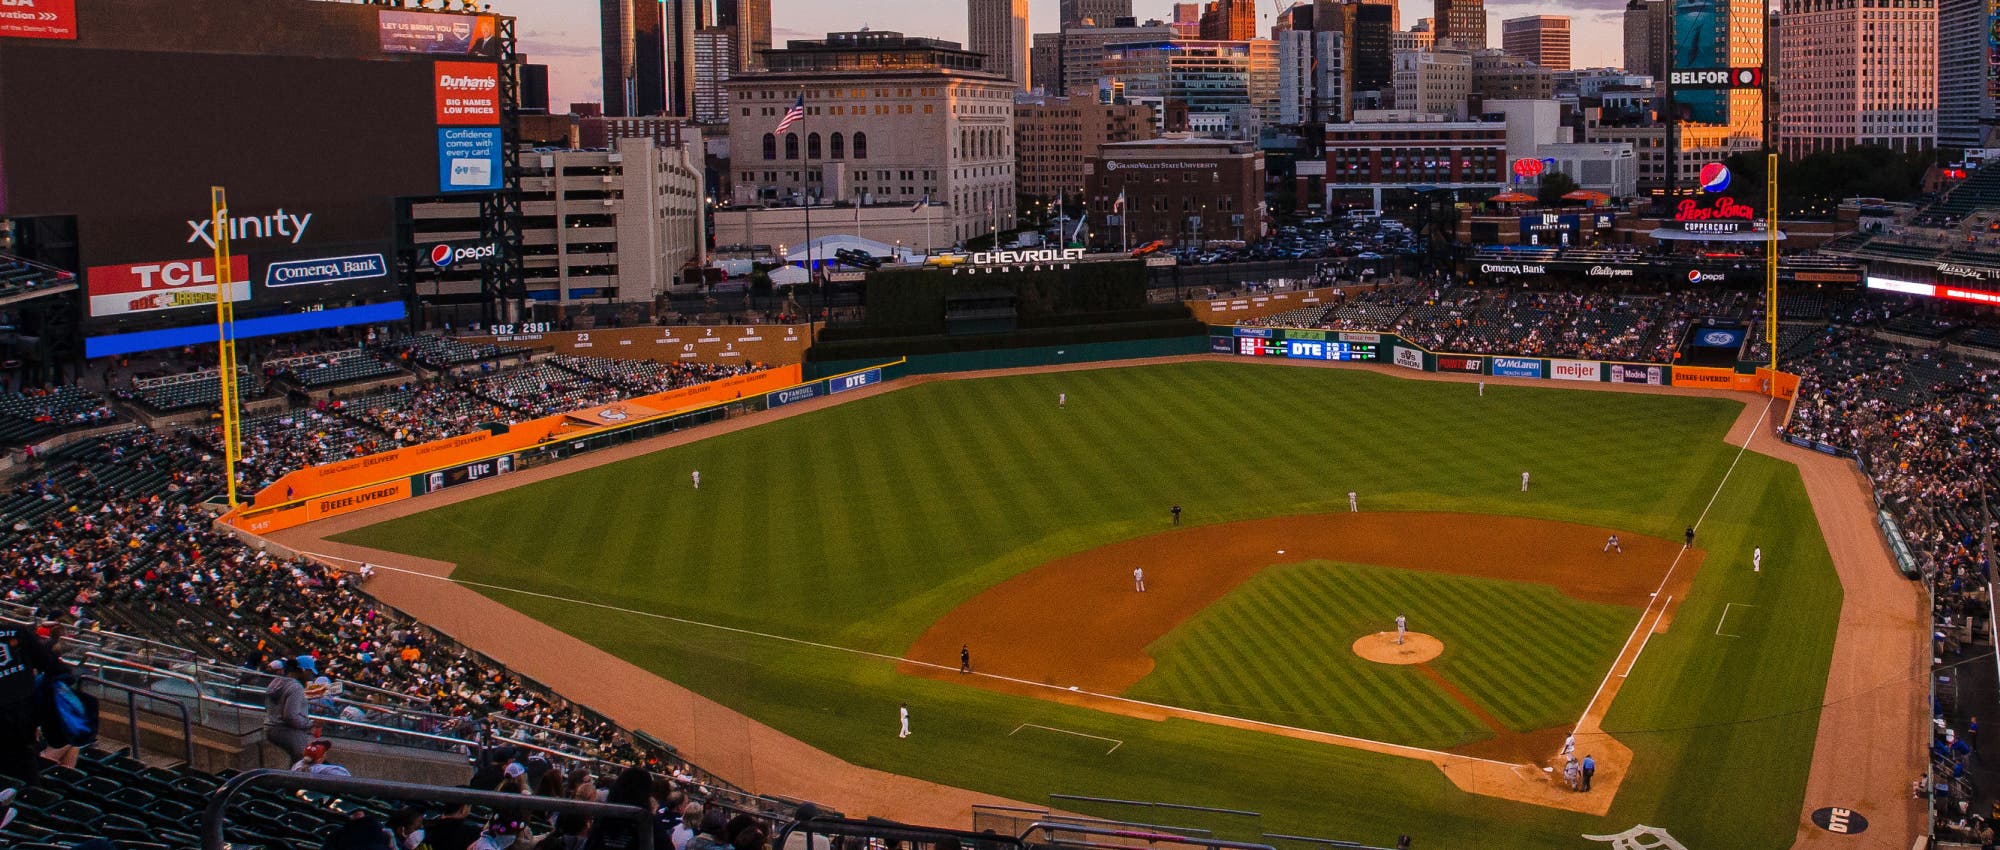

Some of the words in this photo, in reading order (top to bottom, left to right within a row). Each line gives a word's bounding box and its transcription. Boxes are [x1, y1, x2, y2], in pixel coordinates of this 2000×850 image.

[382, 22, 397, 30] LET
[398, 23, 409, 31] US
[410, 24, 434, 32] BRING
[436, 25, 452, 33] YOU
[440, 74, 496, 88] Dunham's
[1671, 71, 1729, 84] BELFOR
[446, 98, 461, 106] BIG
[444, 106, 463, 114] LOW
[445, 130, 492, 139] Confidence
[446, 140, 473, 148] comes
[475, 138, 494, 147] with
[446, 149, 469, 158] every
[187, 208, 313, 250] xfinity
[1684, 223, 1739, 231] COPPERCRAFT
[455, 243, 496, 262] pepsi
[973, 248, 1086, 264] CHEVROLET
[343, 258, 377, 274] Bank
[952, 263, 1070, 275] FOUNTAIN
[1522, 264, 1546, 274] Bank
[1590, 265, 1615, 278] Bally
[131, 261, 215, 288] TCL
[1702, 273, 1725, 281] pepsi
[491, 324, 514, 335] 502
[522, 321, 551, 333] 2981
[665, 329, 671, 337] 5
[706, 328, 712, 336] 2
[577, 333, 589, 341] 23
[683, 343, 694, 351] 47
[1292, 342, 1322, 356] DTE
[1397, 358, 1421, 368] VISION
[1439, 358, 1482, 371] POINTSBET
[1506, 359, 1539, 369] McLaren
[1556, 363, 1594, 378] meijer
[1625, 370, 1646, 379] Modelo
[845, 374, 866, 388] DTE
[467, 462, 490, 480] Lite
[1828, 807, 1851, 833] DTE
